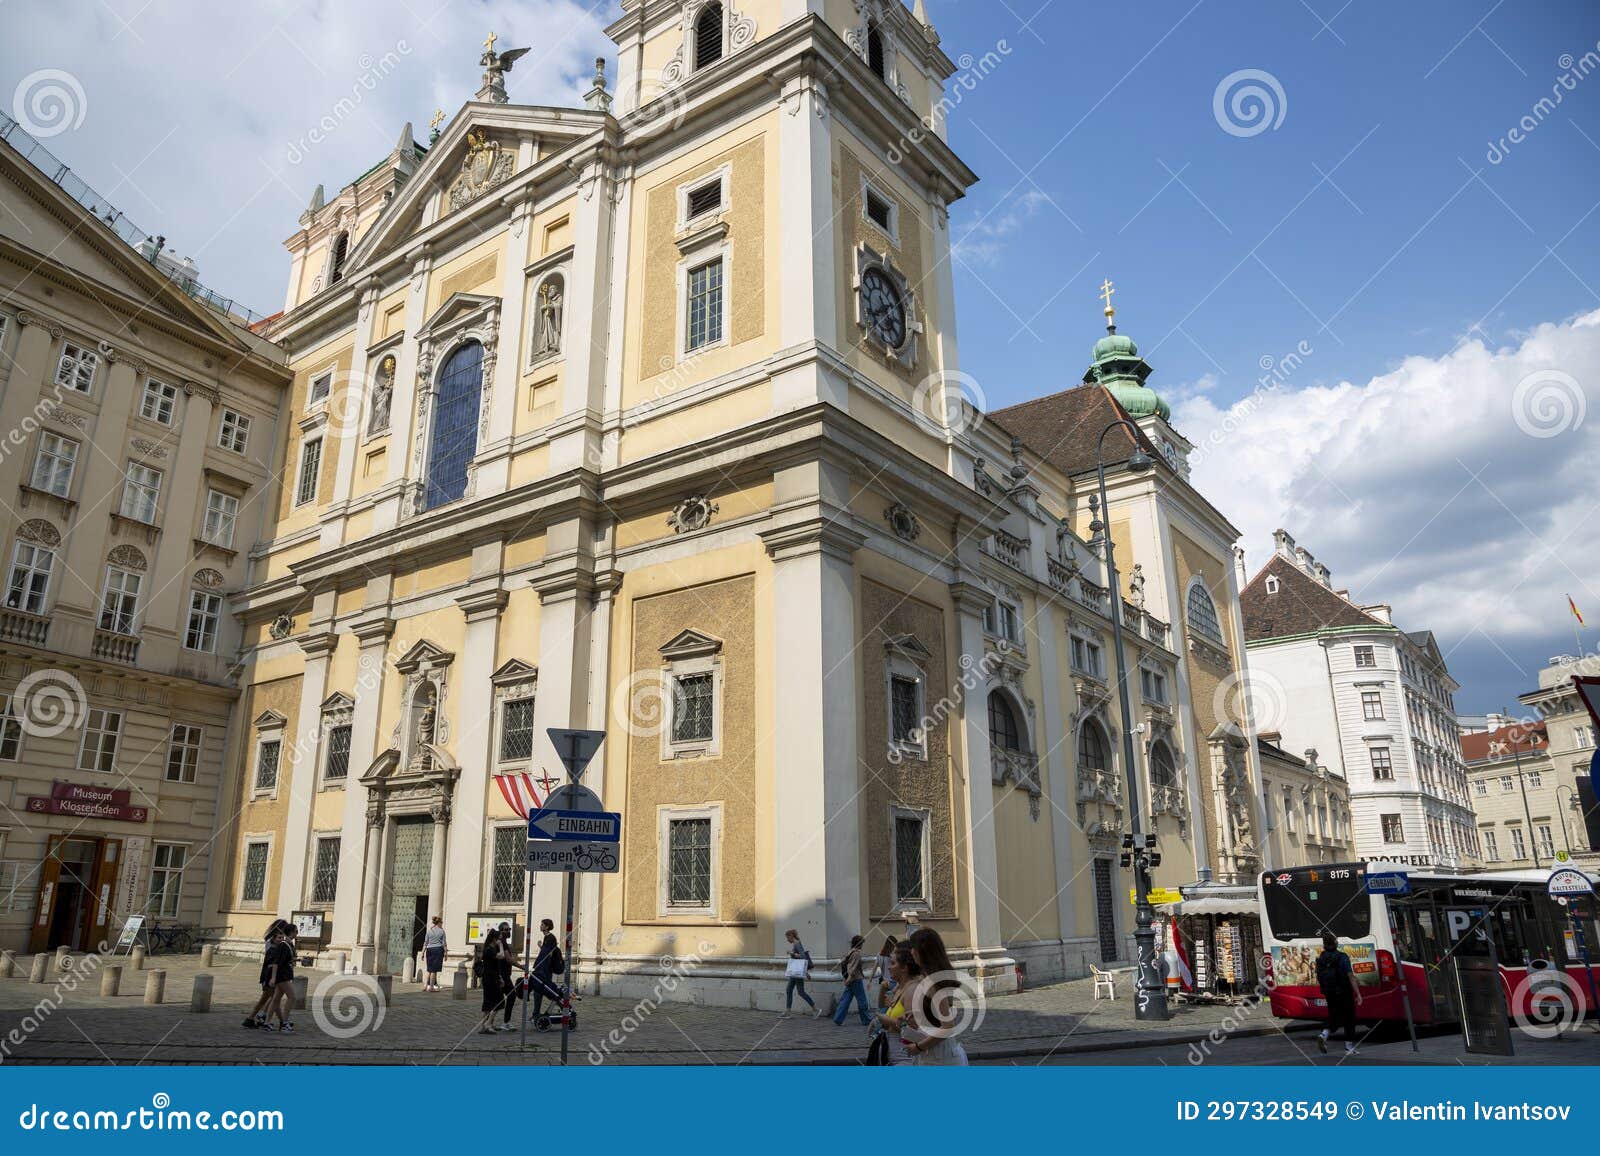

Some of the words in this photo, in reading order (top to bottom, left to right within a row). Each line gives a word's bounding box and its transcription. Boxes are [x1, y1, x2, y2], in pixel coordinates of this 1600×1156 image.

[73, 787, 113, 801] Museum
[60, 799, 120, 815] Klosterladen
[558, 818, 610, 833] EINBAHN
[1330, 870, 1350, 879] 8175
[1370, 877, 1396, 888] EINBAHN
[1448, 911, 1471, 941] P
